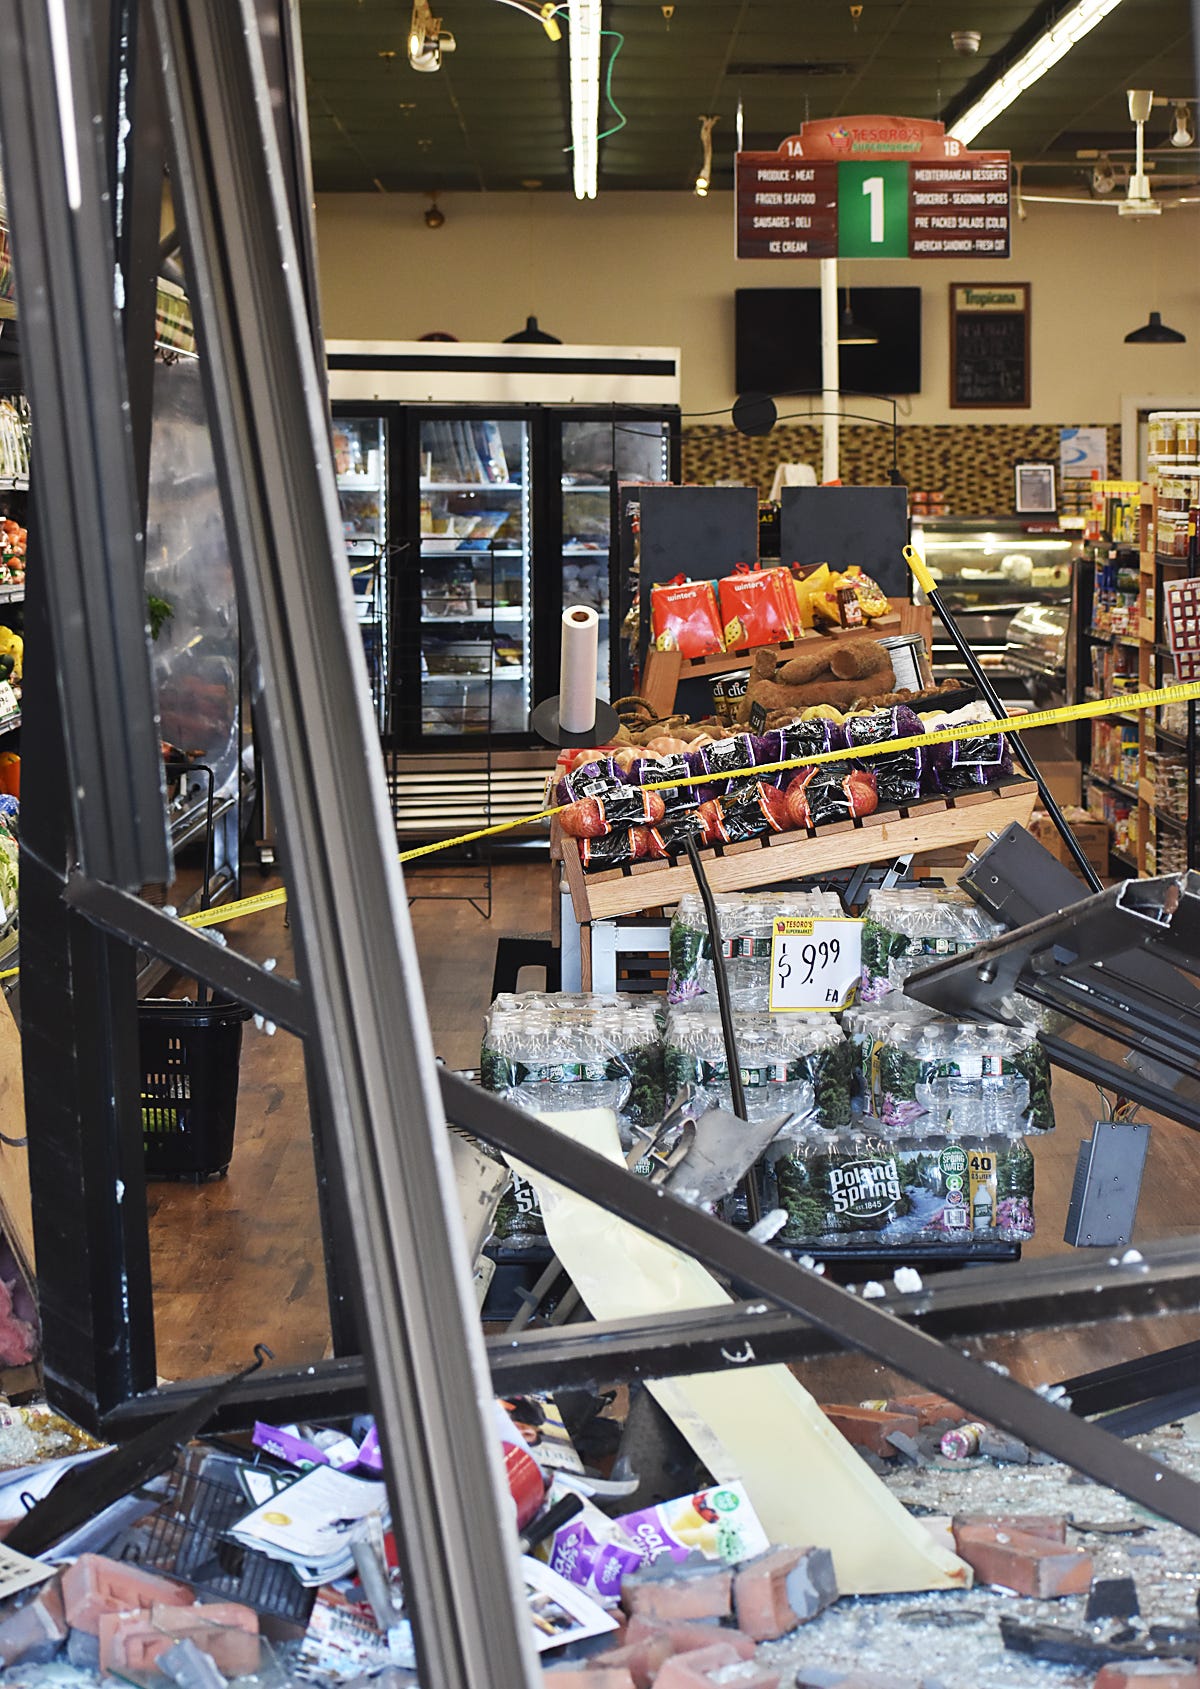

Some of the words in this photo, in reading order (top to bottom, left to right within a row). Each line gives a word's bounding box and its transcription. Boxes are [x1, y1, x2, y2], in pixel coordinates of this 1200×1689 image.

[852, 129, 921, 141] TESORO'S
[787, 141, 804, 157] 1A
[943, 141, 960, 156] 1B
[757, 169, 790, 181] PRODUCE
[795, 169, 815, 181] MEAT
[972, 169, 1007, 181] DESSERTS
[755, 193, 782, 205] FROZEN
[783, 193, 816, 205] SEAFOOD
[862, 177, 885, 243] 1
[753, 216, 790, 228] SAUSAGES
[795, 216, 811, 228] DELI
[914, 216, 929, 228] PRE
[769, 241, 781, 253] ICE
[782, 241, 808, 253] CREAM
[964, 288, 1016, 307] Tropicana
[786, 920, 813, 928] TESORO'S
[825, 988, 839, 1003] EA
[943, 1154, 965, 1164] SPRING
[971, 1156, 992, 1171] 40
[943, 1163, 965, 1171] WATER
[828, 1158, 900, 1194] Poland
[832, 1180, 902, 1213] Spring
[864, 1200, 882, 1210] 1845
[637, 1523, 672, 1563] cak
[553, 1533, 579, 1574] ake
